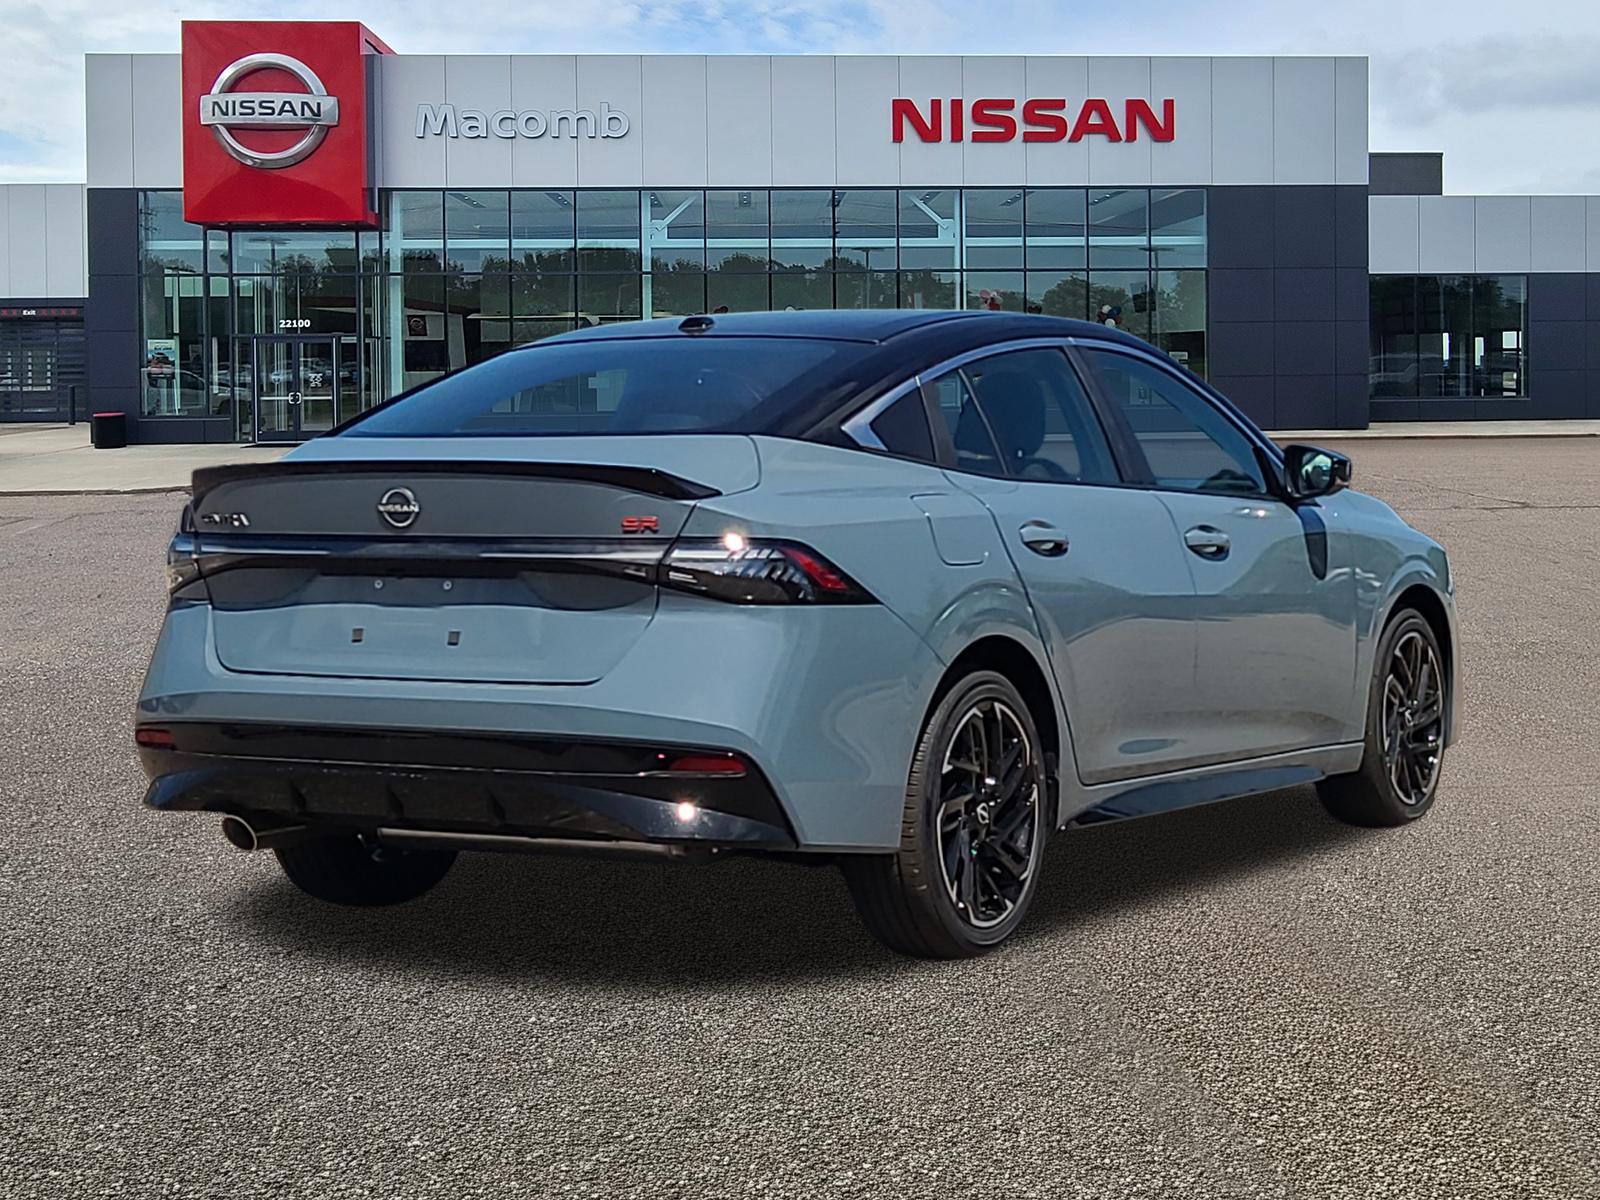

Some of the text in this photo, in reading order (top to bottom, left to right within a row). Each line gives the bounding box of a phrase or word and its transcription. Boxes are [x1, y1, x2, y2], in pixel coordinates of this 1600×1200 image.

[212, 100, 322, 117] NISSAN
[415, 102, 629, 138] Macomb
[892, 98, 1175, 143] NISSAN
[279, 319, 311, 328] 22100
[378, 504, 419, 512] NISSAN
[621, 515, 658, 533] SR
